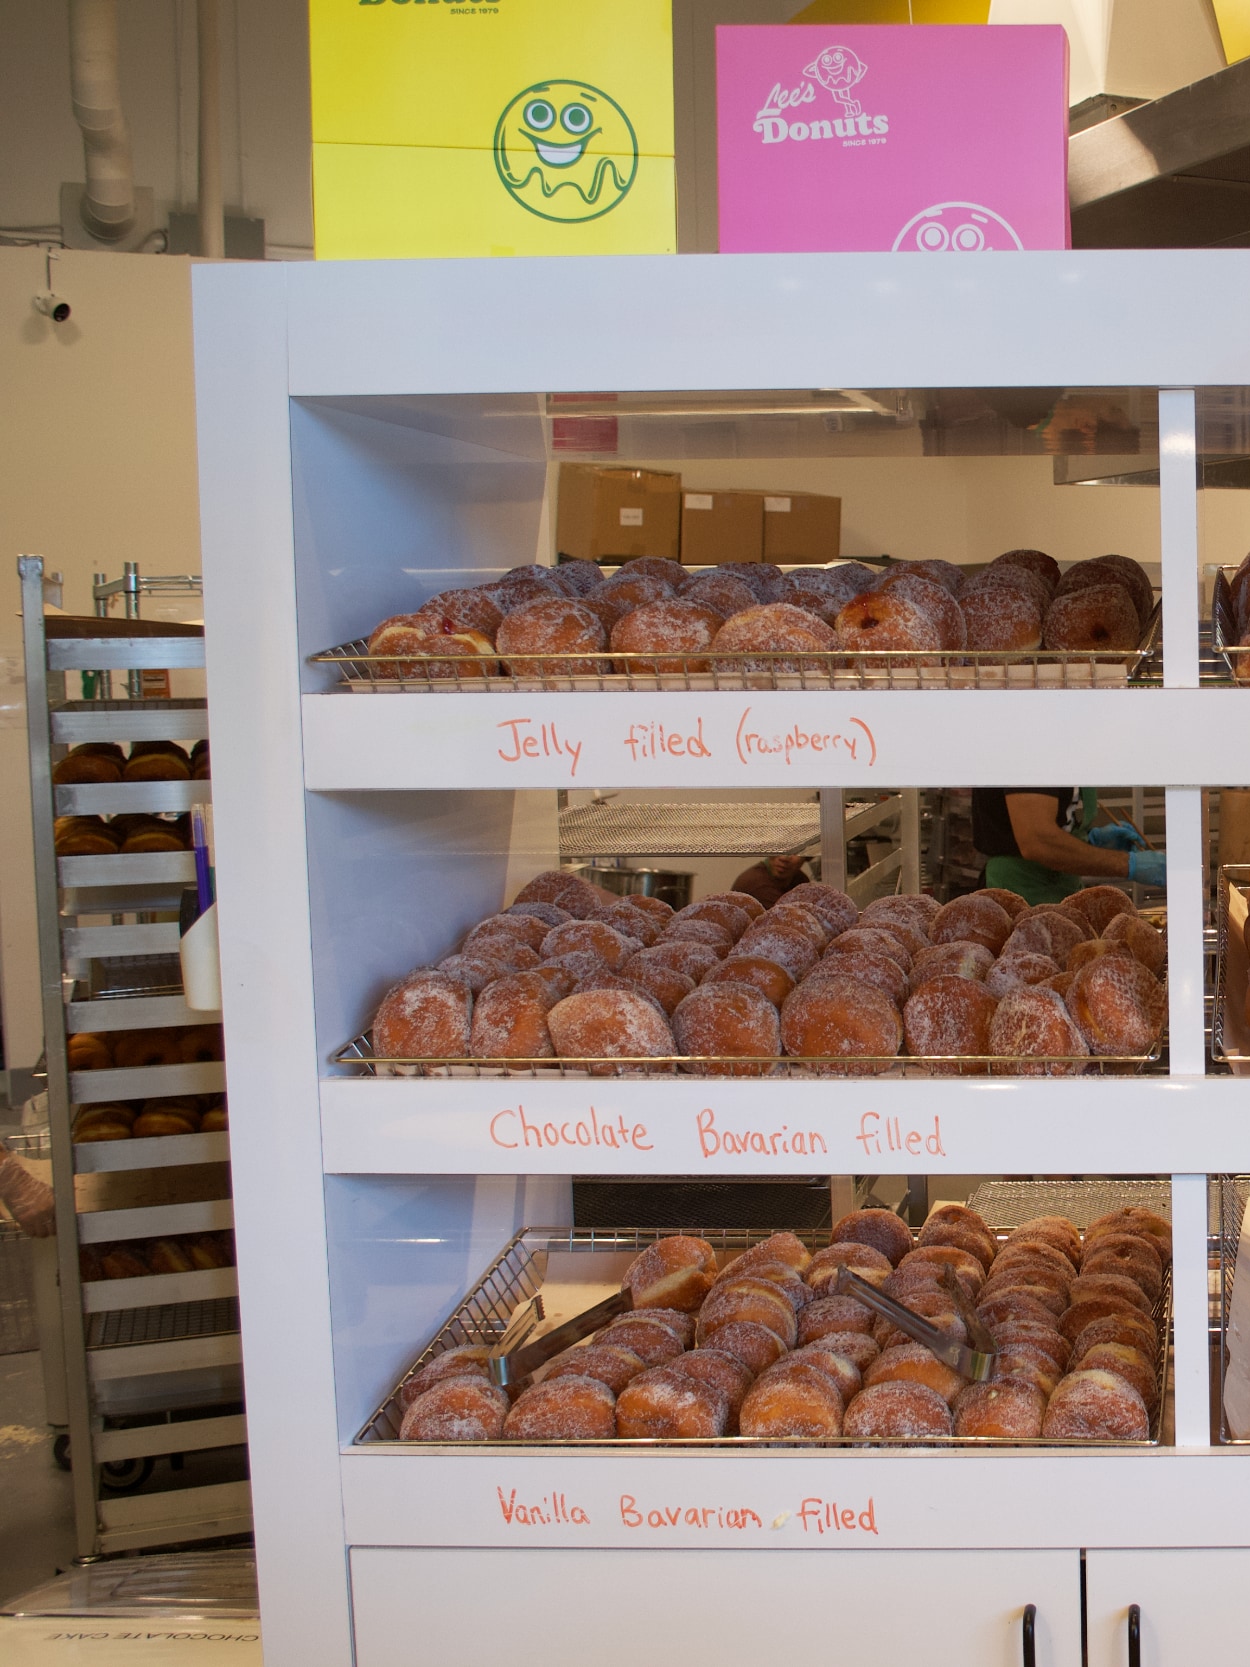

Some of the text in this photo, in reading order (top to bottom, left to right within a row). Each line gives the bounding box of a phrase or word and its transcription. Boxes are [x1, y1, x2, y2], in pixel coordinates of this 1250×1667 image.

[756, 82, 816, 120] Lee's
[753, 112, 889, 144] Donuts
[868, 138, 887, 146] 1979
[497, 706, 876, 777] Jelly filled (raspberry)
[490, 1105, 947, 1159] Chocolate Bavarian filled
[497, 1486, 880, 1535] Vanilla Bavarian filled
[46, 1632, 259, 1642] CHOCOLATE CAKE
